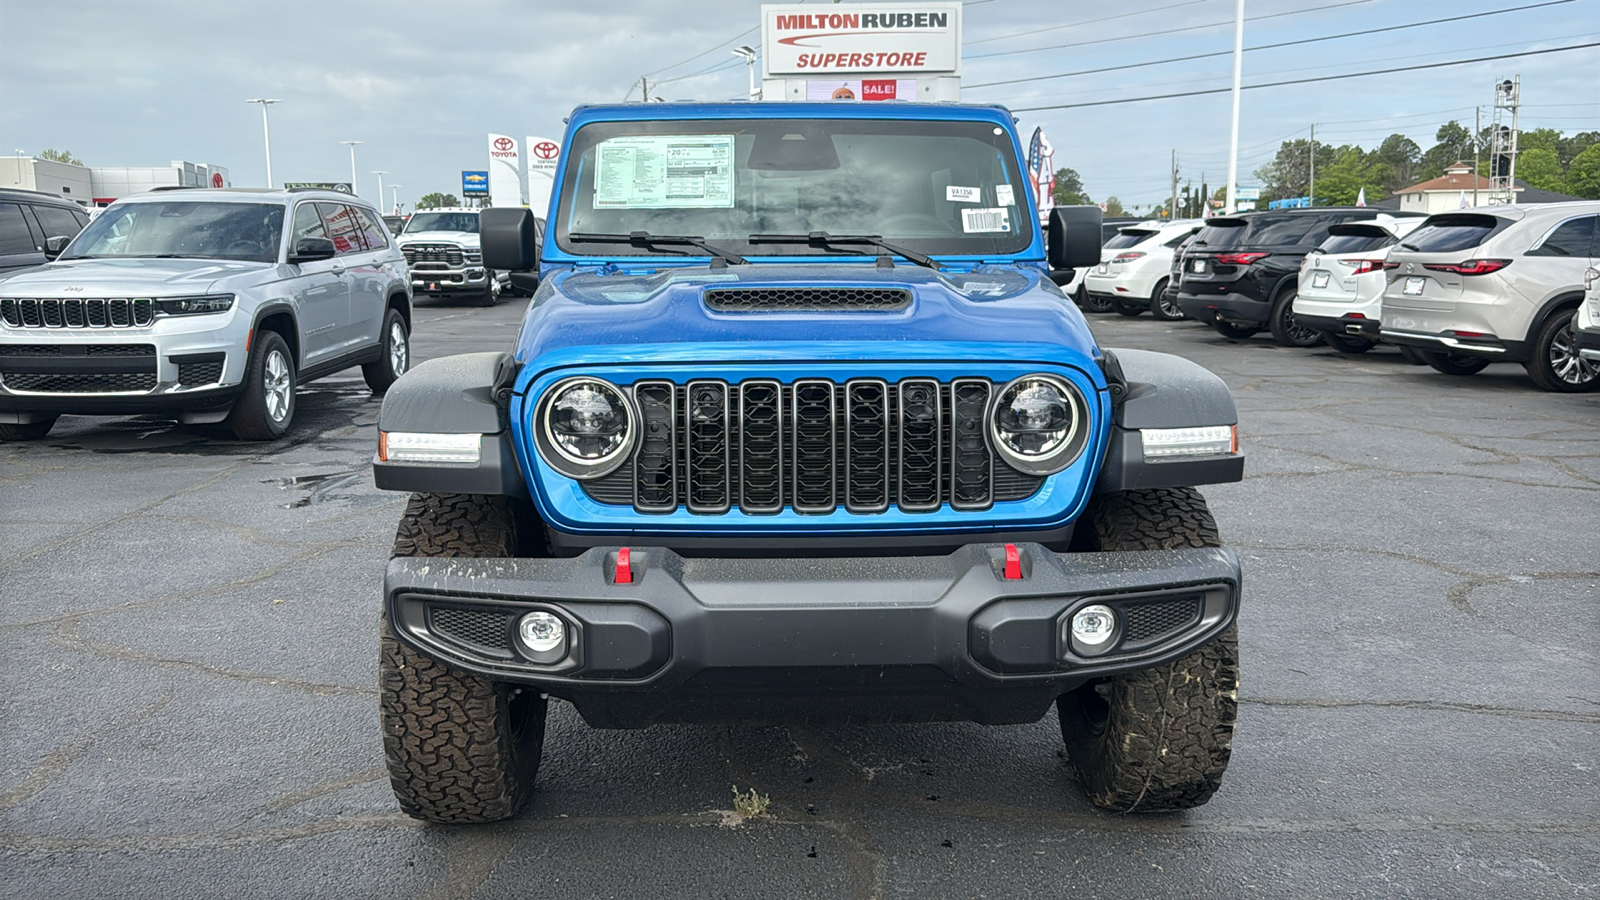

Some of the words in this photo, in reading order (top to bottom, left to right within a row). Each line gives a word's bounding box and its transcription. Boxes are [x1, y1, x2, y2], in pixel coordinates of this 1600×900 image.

[776, 13, 859, 30] MILTON
[861, 12, 948, 29] RUBEN
[796, 52, 928, 68] SUPERSTORE
[863, 84, 896, 95] SALE!
